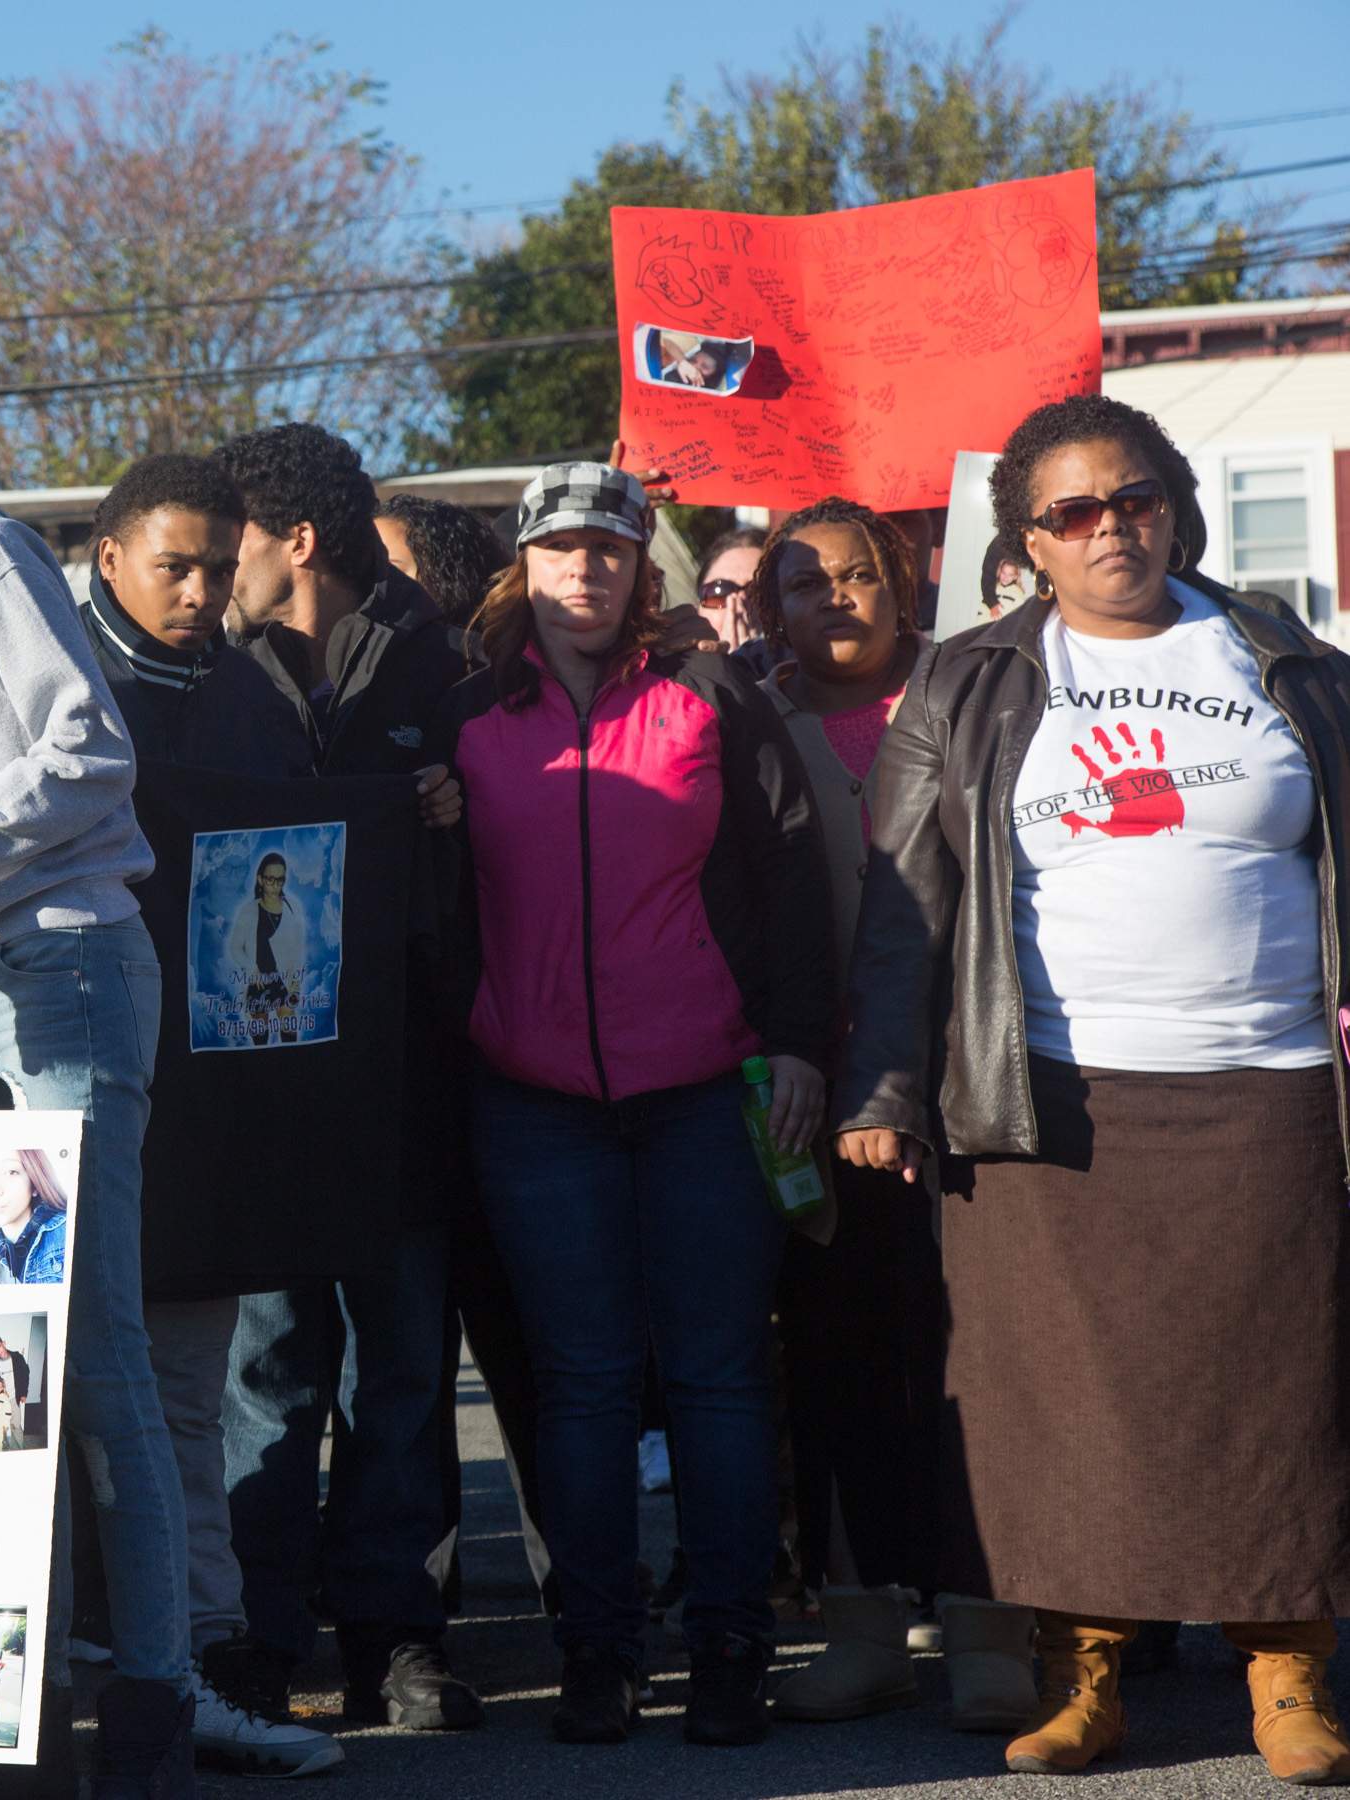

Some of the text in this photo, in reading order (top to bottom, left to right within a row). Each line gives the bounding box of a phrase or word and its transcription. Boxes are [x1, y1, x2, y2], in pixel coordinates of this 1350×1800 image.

[1047, 686, 1254, 727] EWBURGH
[1013, 796, 1068, 826] STOP
[1078, 783, 1126, 806] THE
